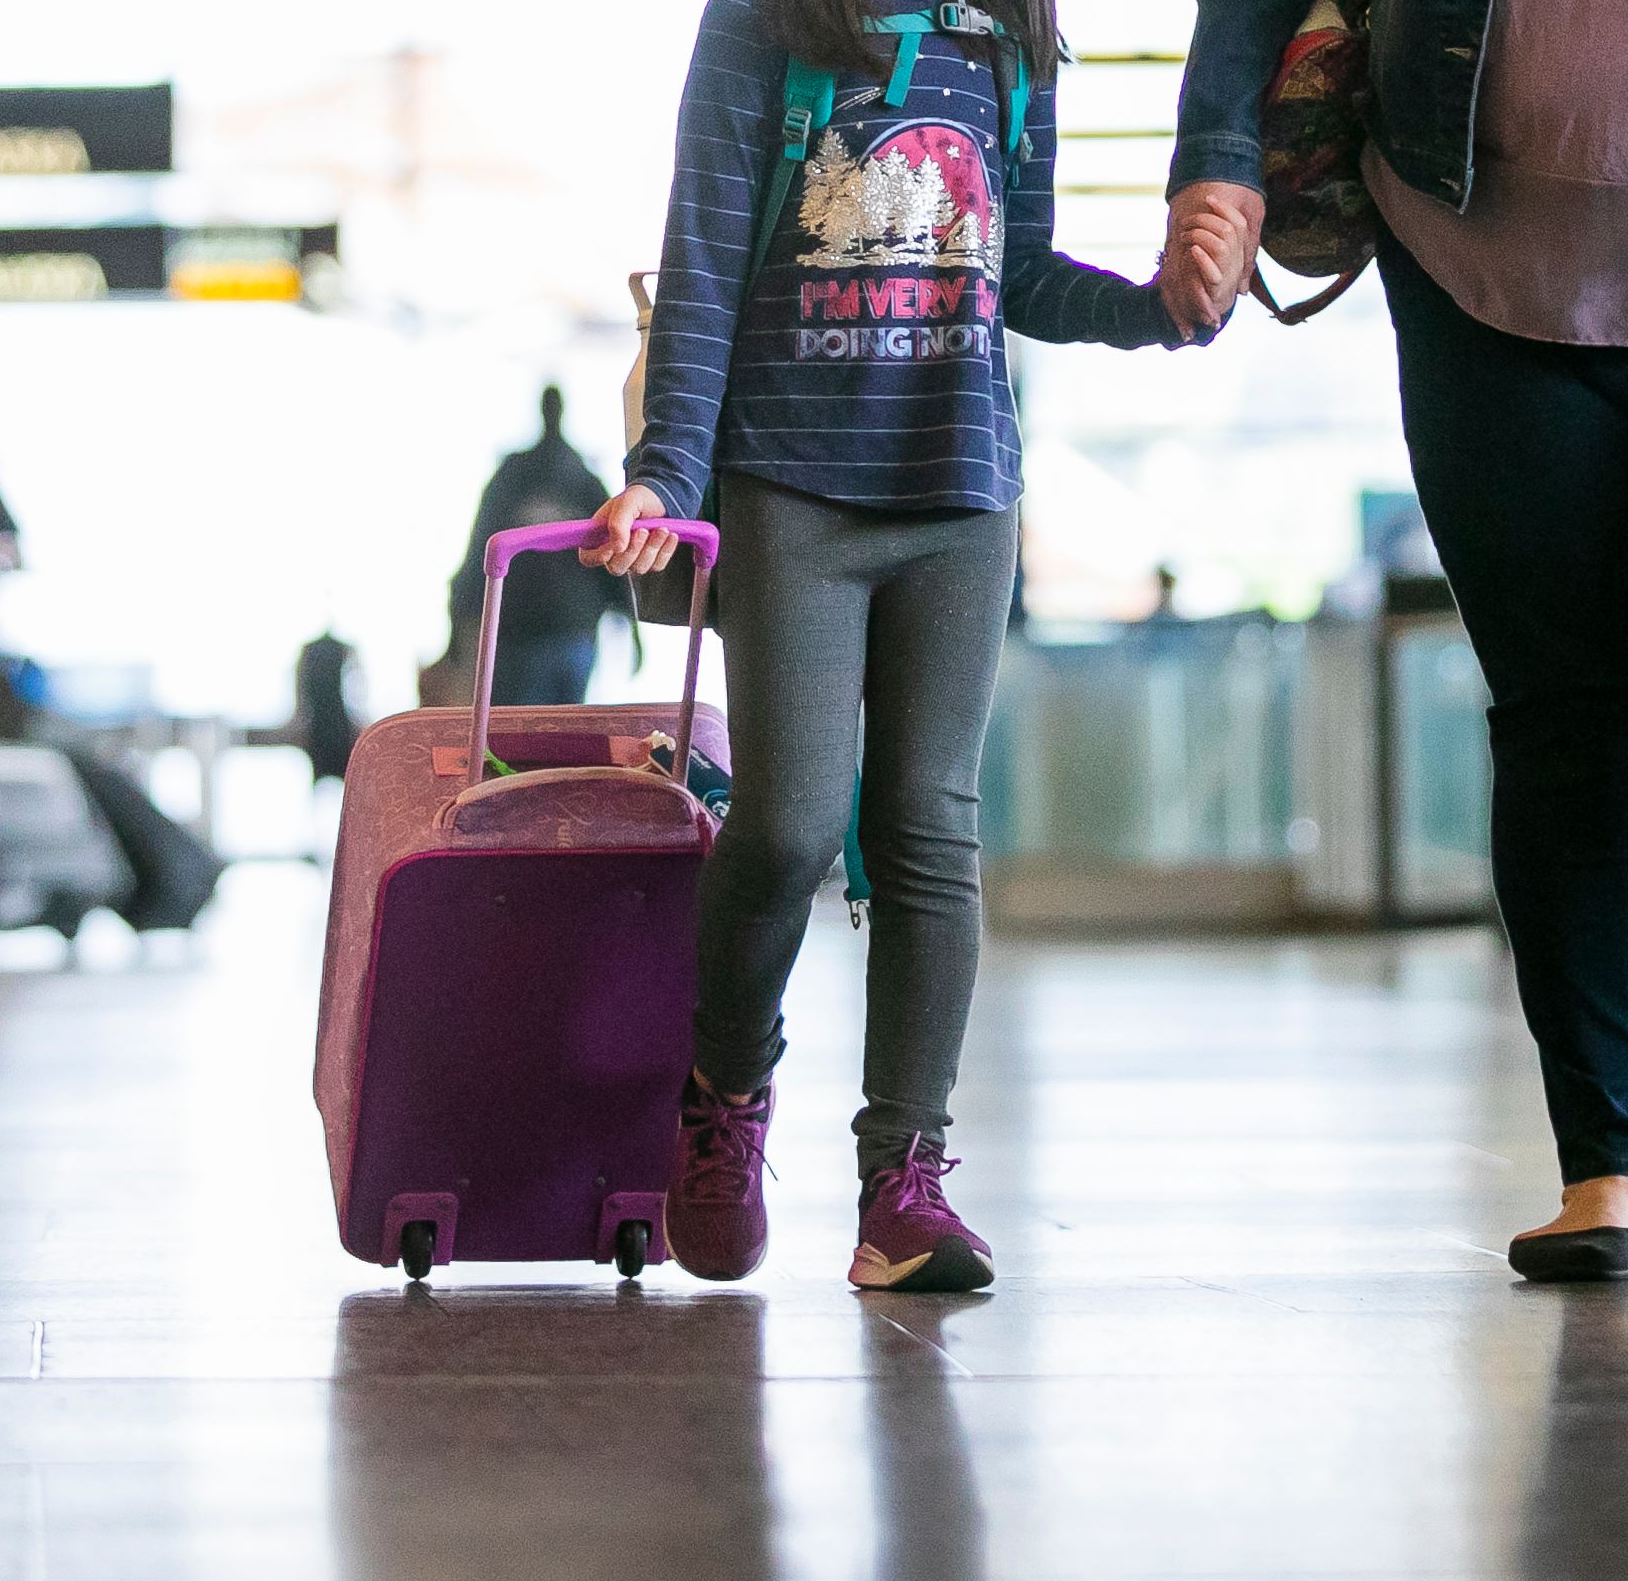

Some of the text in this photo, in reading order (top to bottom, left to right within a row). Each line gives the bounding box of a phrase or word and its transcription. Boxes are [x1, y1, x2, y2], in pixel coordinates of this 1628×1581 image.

[800, 279, 860, 320] I'M
[862, 276, 968, 320] VERY
[796, 327, 914, 361] DOING
